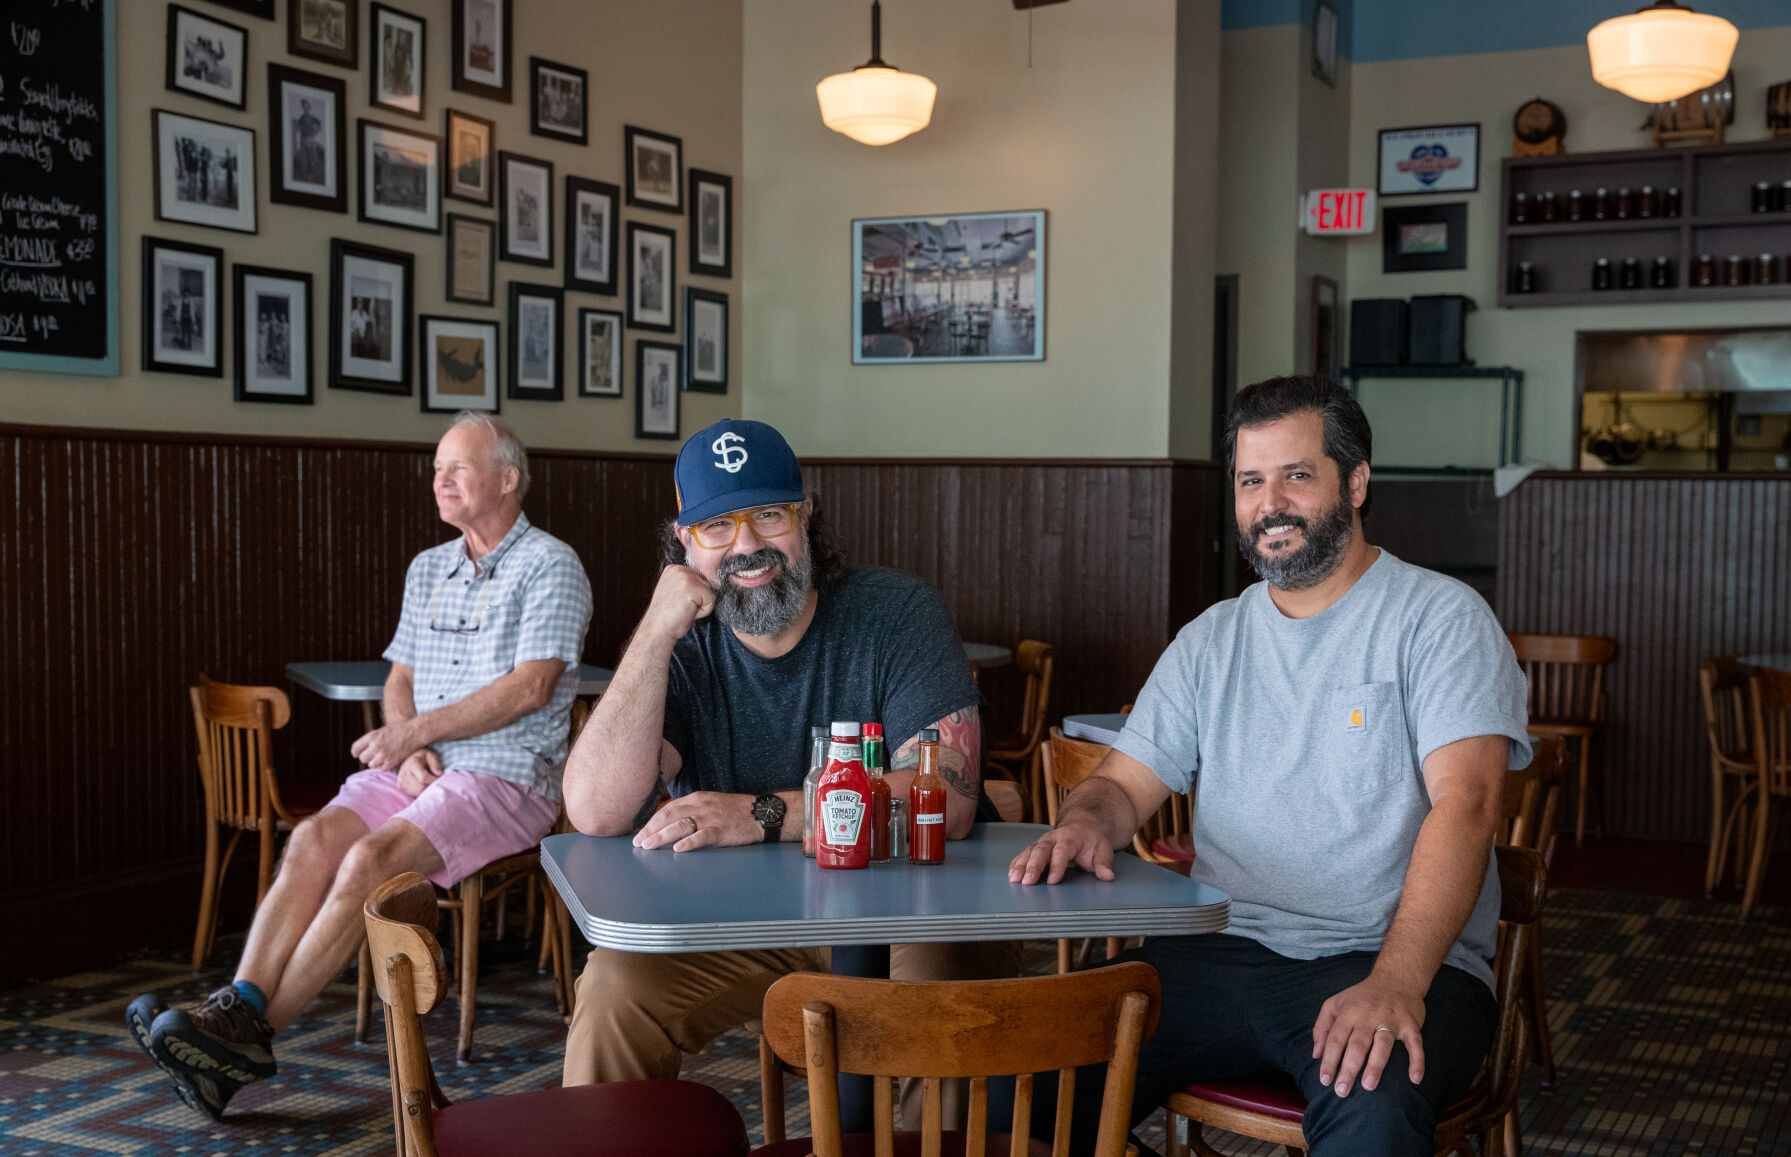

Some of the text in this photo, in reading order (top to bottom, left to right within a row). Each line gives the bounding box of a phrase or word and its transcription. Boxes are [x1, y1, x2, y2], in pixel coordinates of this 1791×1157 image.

[1318, 191, 1367, 230] EXIT
[834, 795, 856, 803] HEINZ
[831, 807, 857, 815] TOMATO
